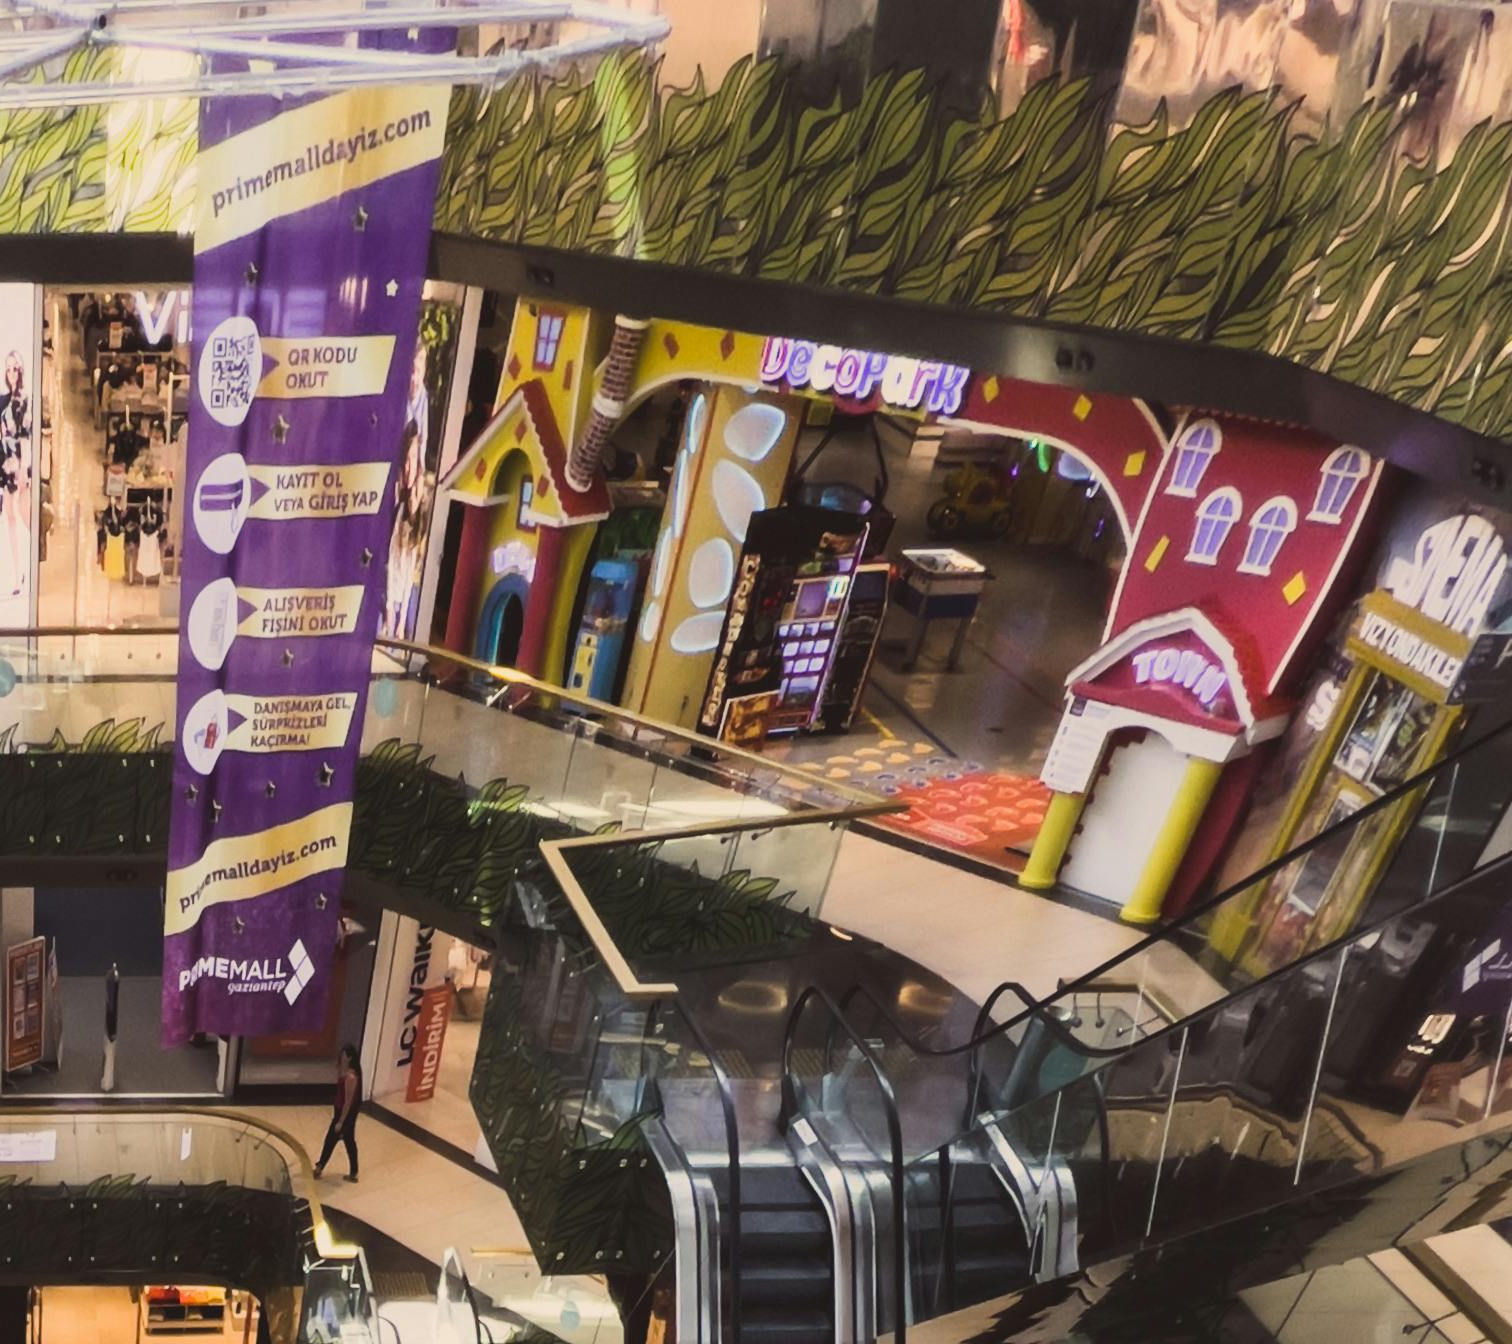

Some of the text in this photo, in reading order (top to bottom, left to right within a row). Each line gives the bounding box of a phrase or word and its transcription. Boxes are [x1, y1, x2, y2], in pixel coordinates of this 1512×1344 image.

[211, 109, 432, 218] primemalldayiz.com
[287, 346, 358, 367] QR KODU
[285, 371, 329, 389] OKUT
[275, 471, 343, 490] KAYIT OL
[274, 497, 305, 513] VEYA
[351, 491, 379, 507] YAP
[308, 613, 348, 632] OKUT
[1132, 648, 1227, 707] TOWN
